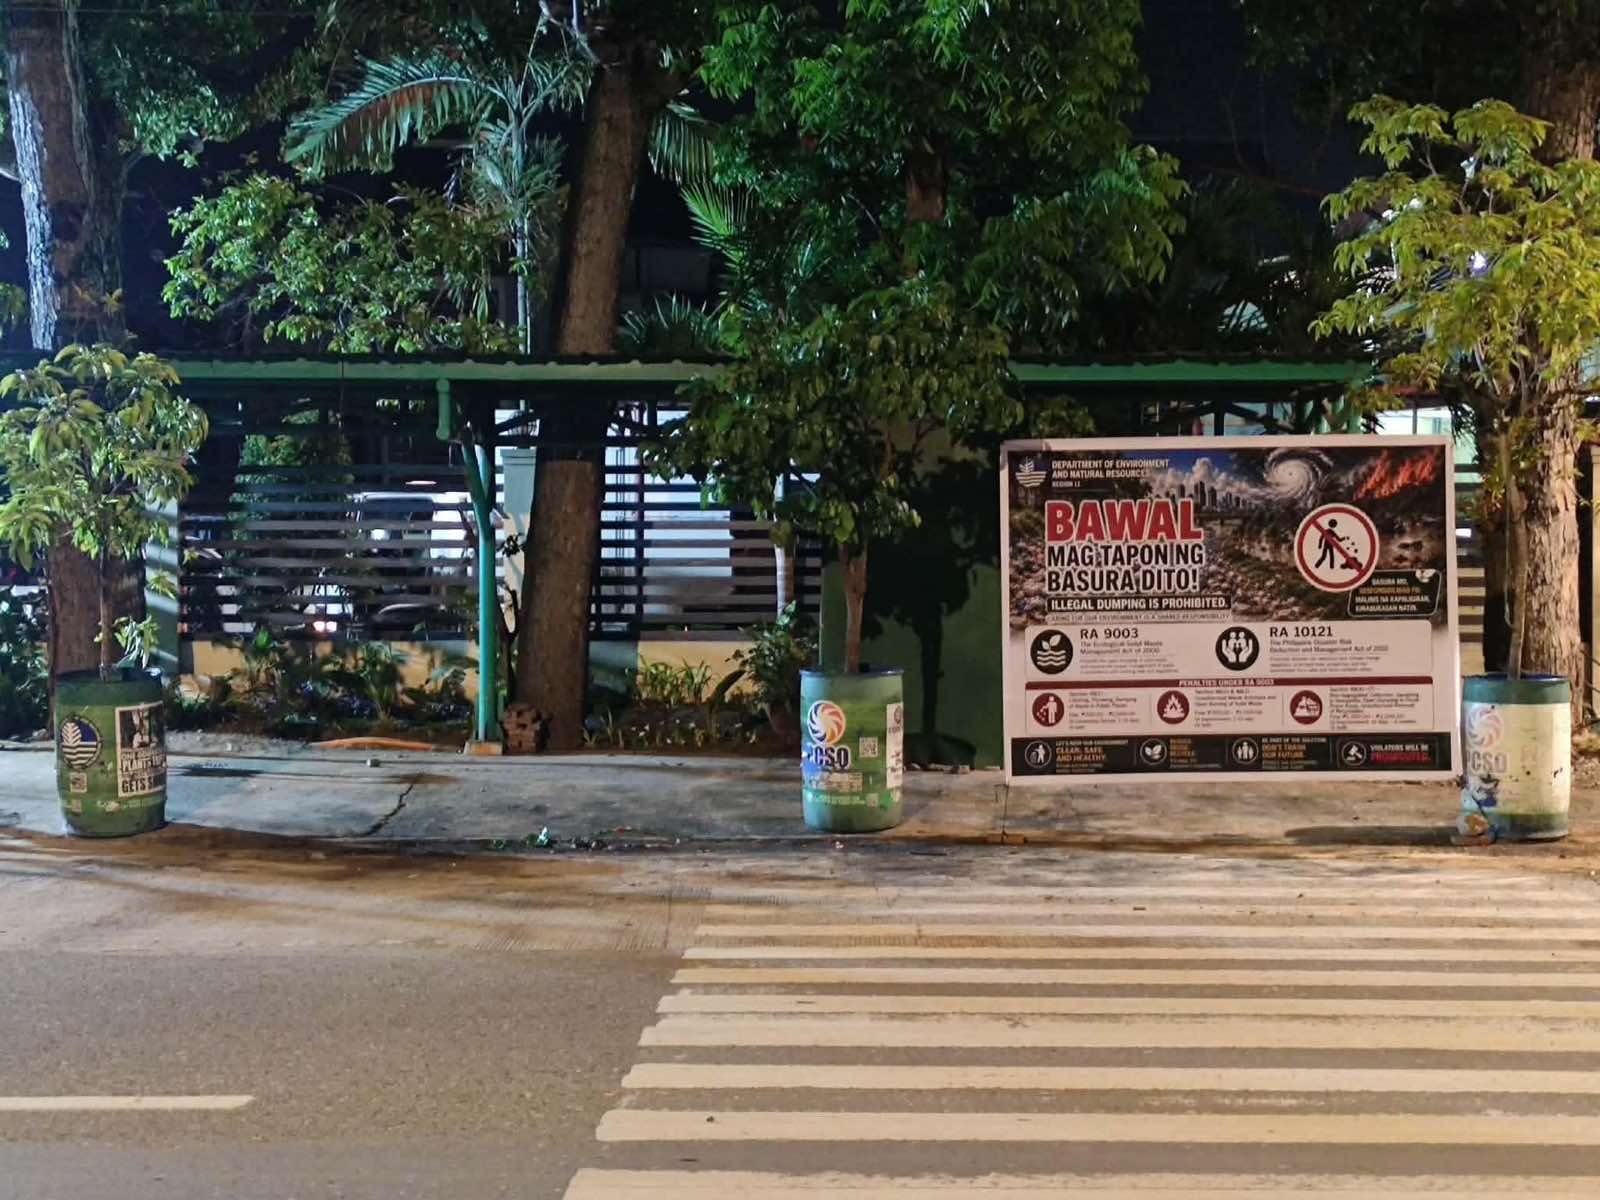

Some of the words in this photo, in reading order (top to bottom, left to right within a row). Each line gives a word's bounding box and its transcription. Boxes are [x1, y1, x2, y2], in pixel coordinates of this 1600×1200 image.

[1052, 460, 1103, 469] DEPARTMENT
[1105, 460, 1114, 469] OF
[1116, 459, 1169, 468] ENVIRONMENT
[1052, 470, 1069, 479] AND
[1070, 470, 1104, 479] NATURAL
[1106, 469, 1149, 478] RESOURCES
[1046, 499, 1203, 542] BAWAL
[1047, 546, 1094, 567] MAG
[1101, 545, 1168, 566] TAPON
[1175, 544, 1203, 565] NG
[1047, 570, 1135, 592] BASURA
[1141, 568, 1198, 591] DITO!
[1051, 599, 1094, 610] ILLEGAL
[1097, 598, 1146, 610] DUMPING
[1149, 598, 1159, 609] IS
[1162, 597, 1229, 609] PROHIBITED.
[1080, 628, 1098, 639] RA
[1104, 628, 1138, 639] 9003
[1270, 627, 1288, 638] RA
[1294, 626, 1333, 637] 10121
